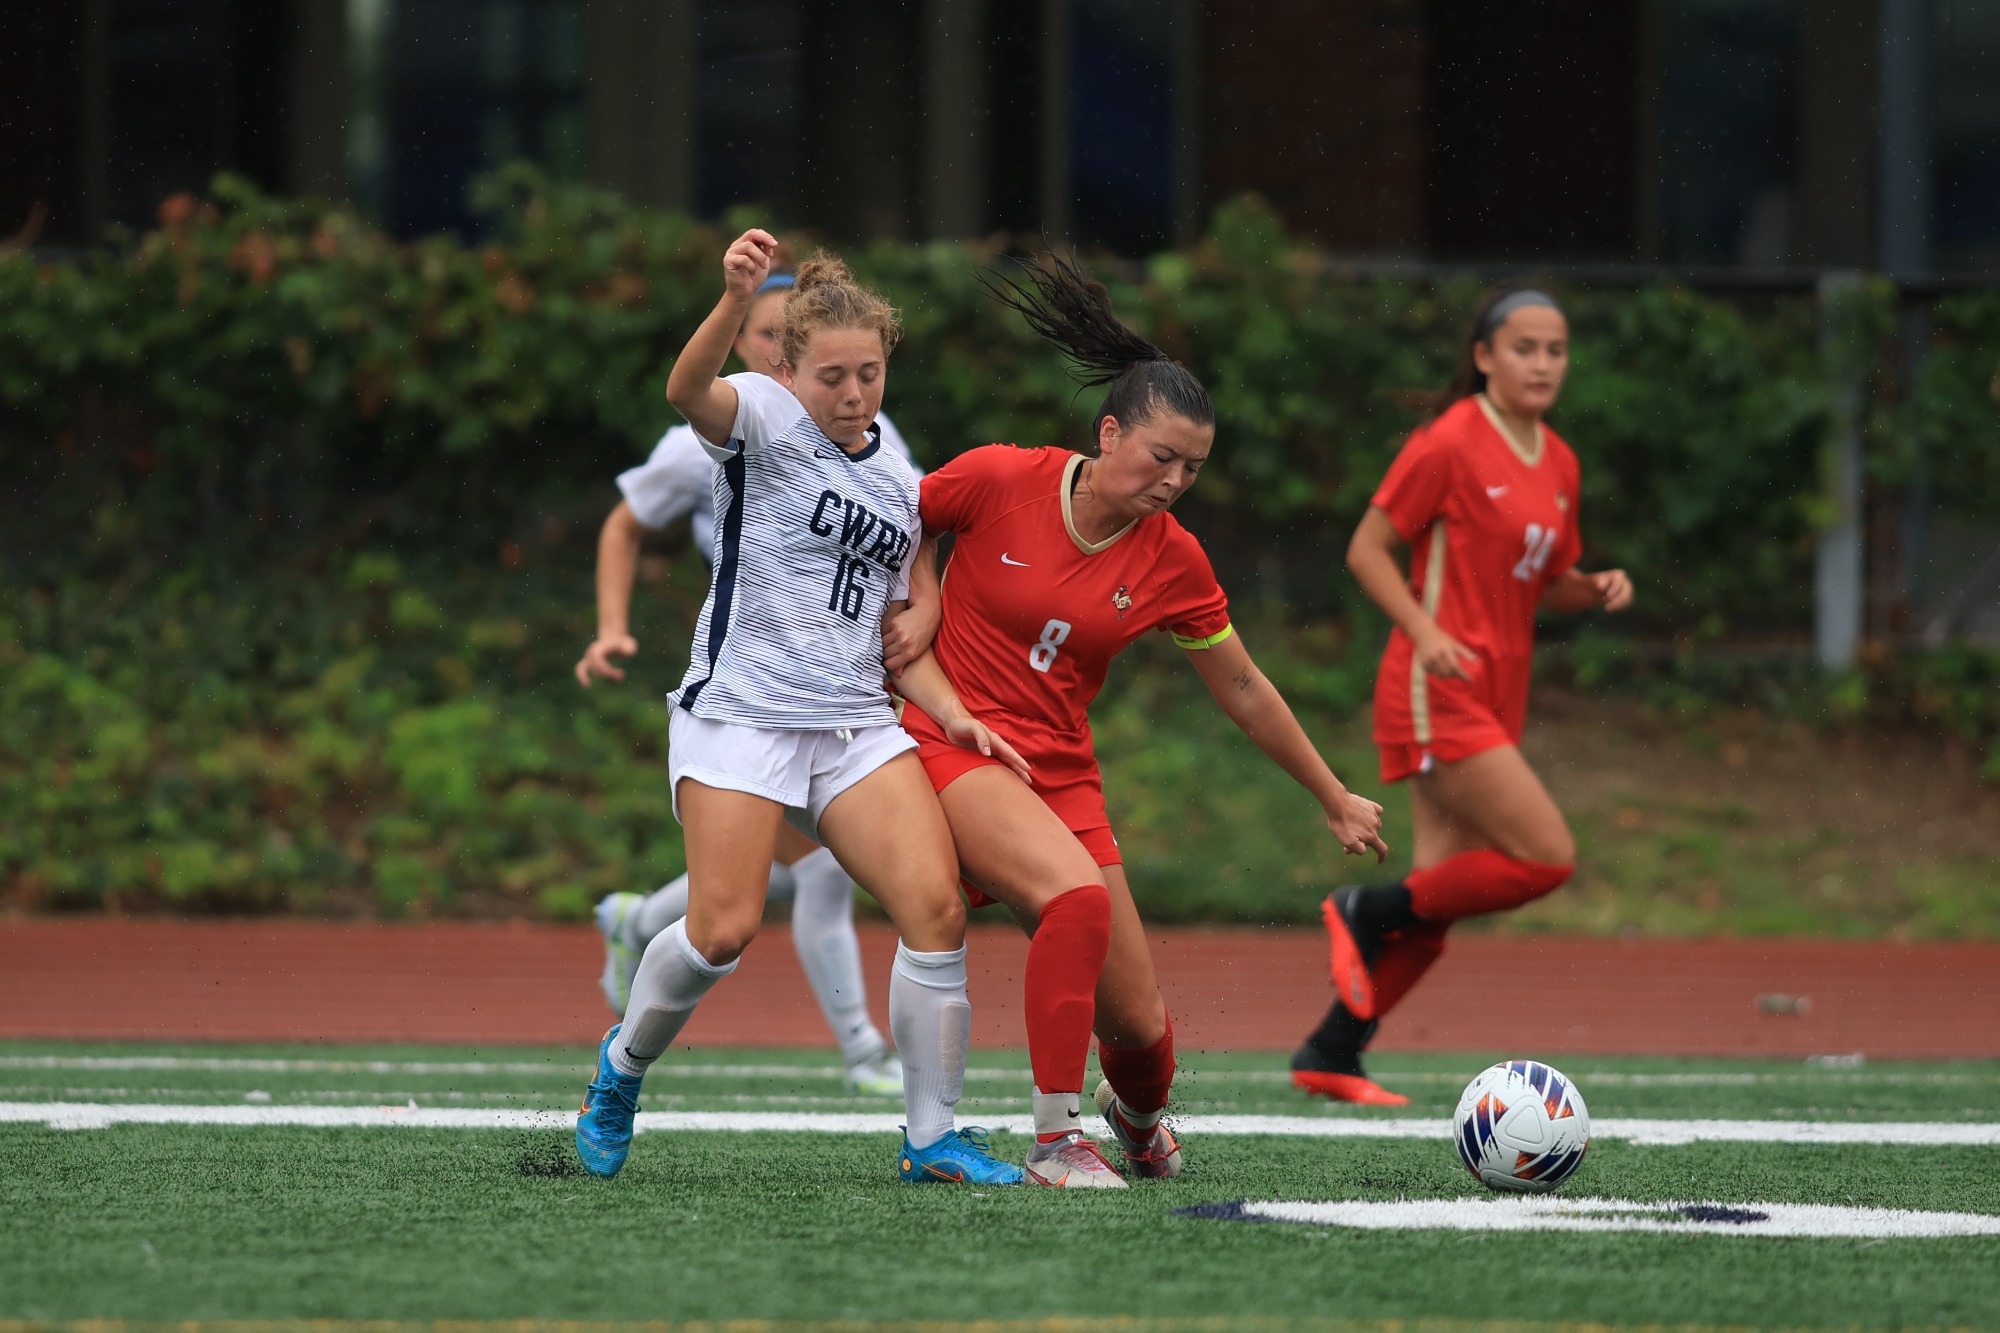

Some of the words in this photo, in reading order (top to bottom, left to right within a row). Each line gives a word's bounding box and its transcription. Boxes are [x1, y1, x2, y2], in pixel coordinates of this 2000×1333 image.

[1512, 523, 1556, 580] 24
[828, 553, 870, 622] 16
[1029, 618, 1072, 673] 8
